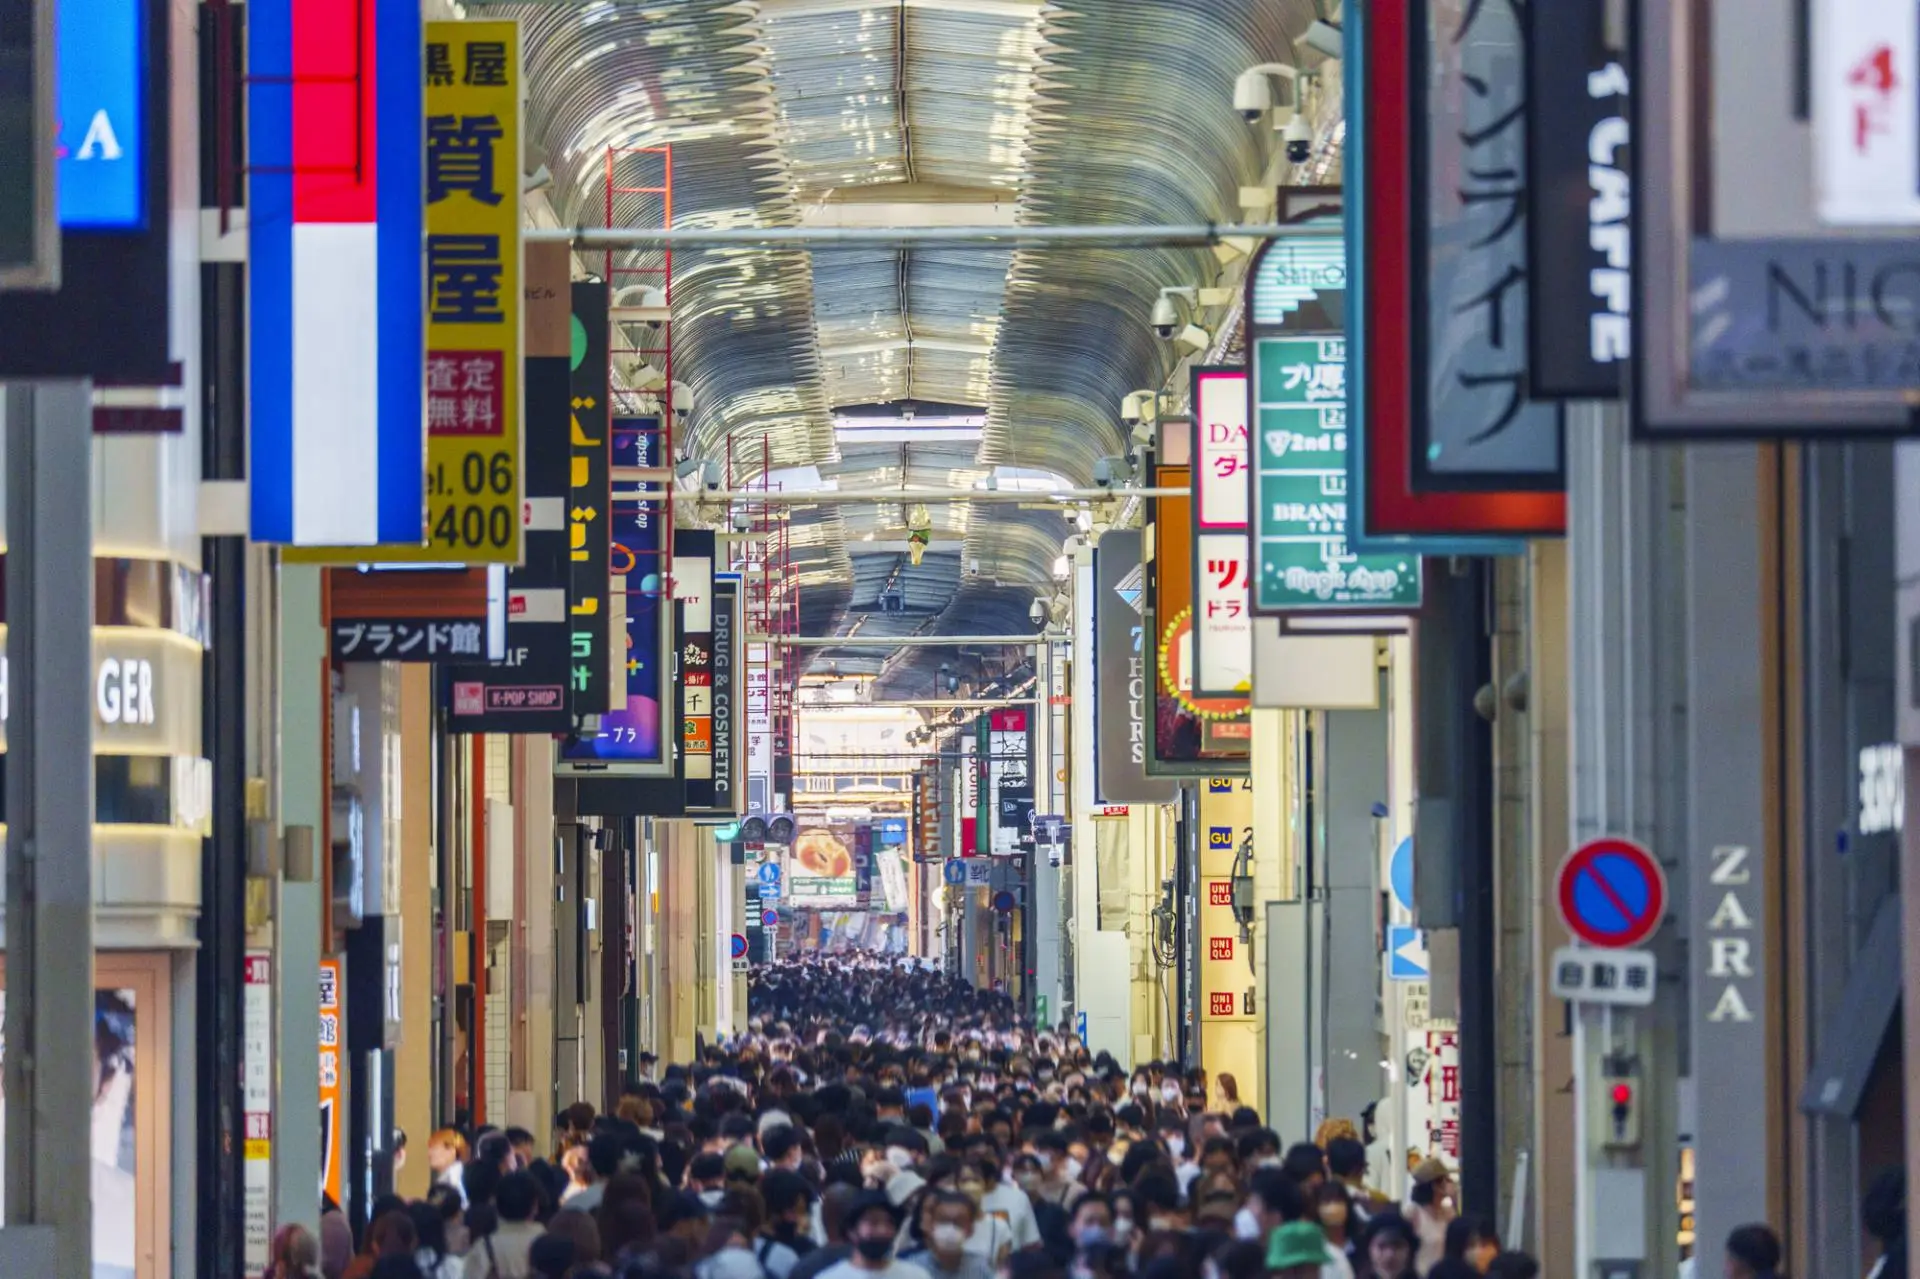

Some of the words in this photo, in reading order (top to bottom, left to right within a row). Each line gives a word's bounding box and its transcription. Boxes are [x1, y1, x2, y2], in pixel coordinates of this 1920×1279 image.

[427, 42, 508, 87] 黒屋
[463, 451, 513, 496] 06
[427, 504, 512, 549] 400
[1207, 560, 1249, 589] ツ
[714, 613, 729, 668] DRUG
[714, 692, 729, 792] COSMETIC
[1210, 831, 1232, 845] GU
[1211, 884, 1230, 894] UNI
[1211, 894, 1231, 904] QLO
[1211, 939, 1230, 949] UNI
[1708, 846, 1754, 1022] ZARA
[1212, 949, 1231, 959] QLO
[1558, 961, 1650, 990] 自動車
[1212, 994, 1230, 1003] UNI
[1212, 1004, 1232, 1013] QLO
